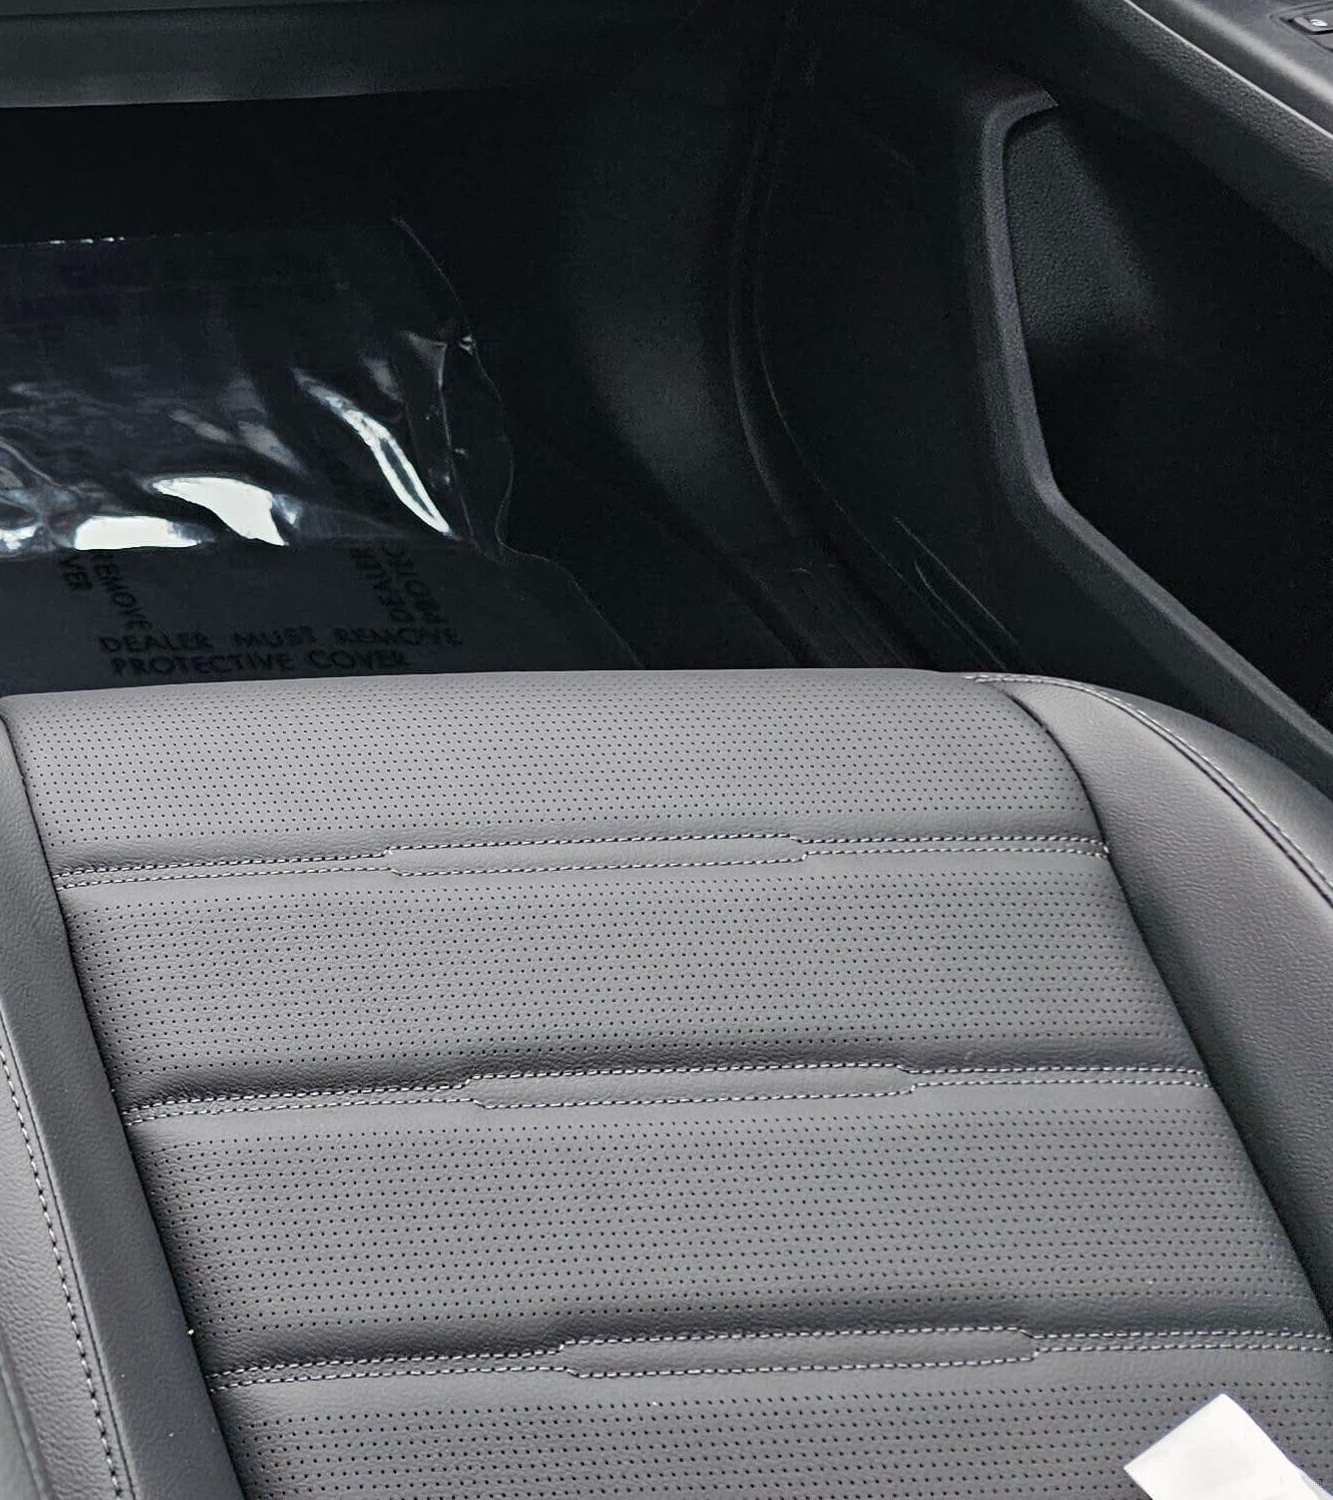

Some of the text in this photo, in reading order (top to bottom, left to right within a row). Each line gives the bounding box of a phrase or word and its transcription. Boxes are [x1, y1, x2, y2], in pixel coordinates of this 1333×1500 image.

[97, 631, 214, 653] DEALER
[231, 626, 318, 648] MUST
[111, 649, 412, 677] PROTECTIVE COVER
